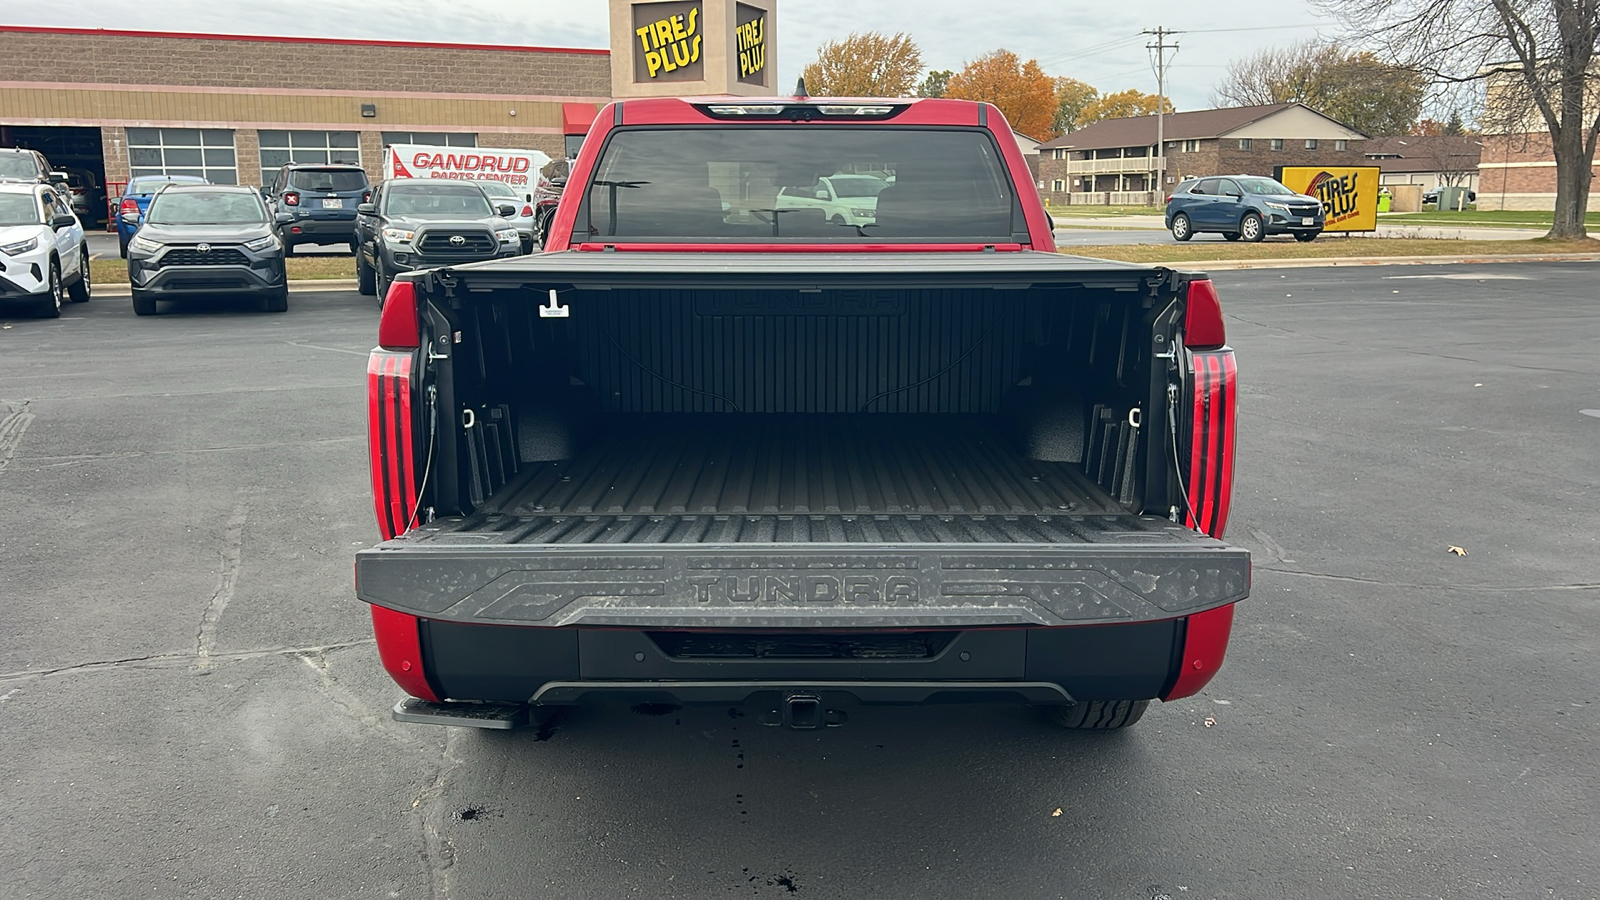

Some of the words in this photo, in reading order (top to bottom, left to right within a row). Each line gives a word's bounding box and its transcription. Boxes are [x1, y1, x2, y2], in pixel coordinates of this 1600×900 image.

[636, 7, 698, 52] TIRES
[736, 17, 763, 51] TIRES
[645, 34, 701, 78] PLUS
[740, 43, 765, 78] PLUS
[412, 152, 530, 173] GANDRUD
[430, 171, 475, 180] PARTS
[477, 172, 528, 185] CENTER
[1316, 172, 1358, 202] TIRES
[1322, 192, 1358, 218] PLUS
[1324, 219, 1337, 227] OTAL
[685, 576, 919, 602] TUNDRA
